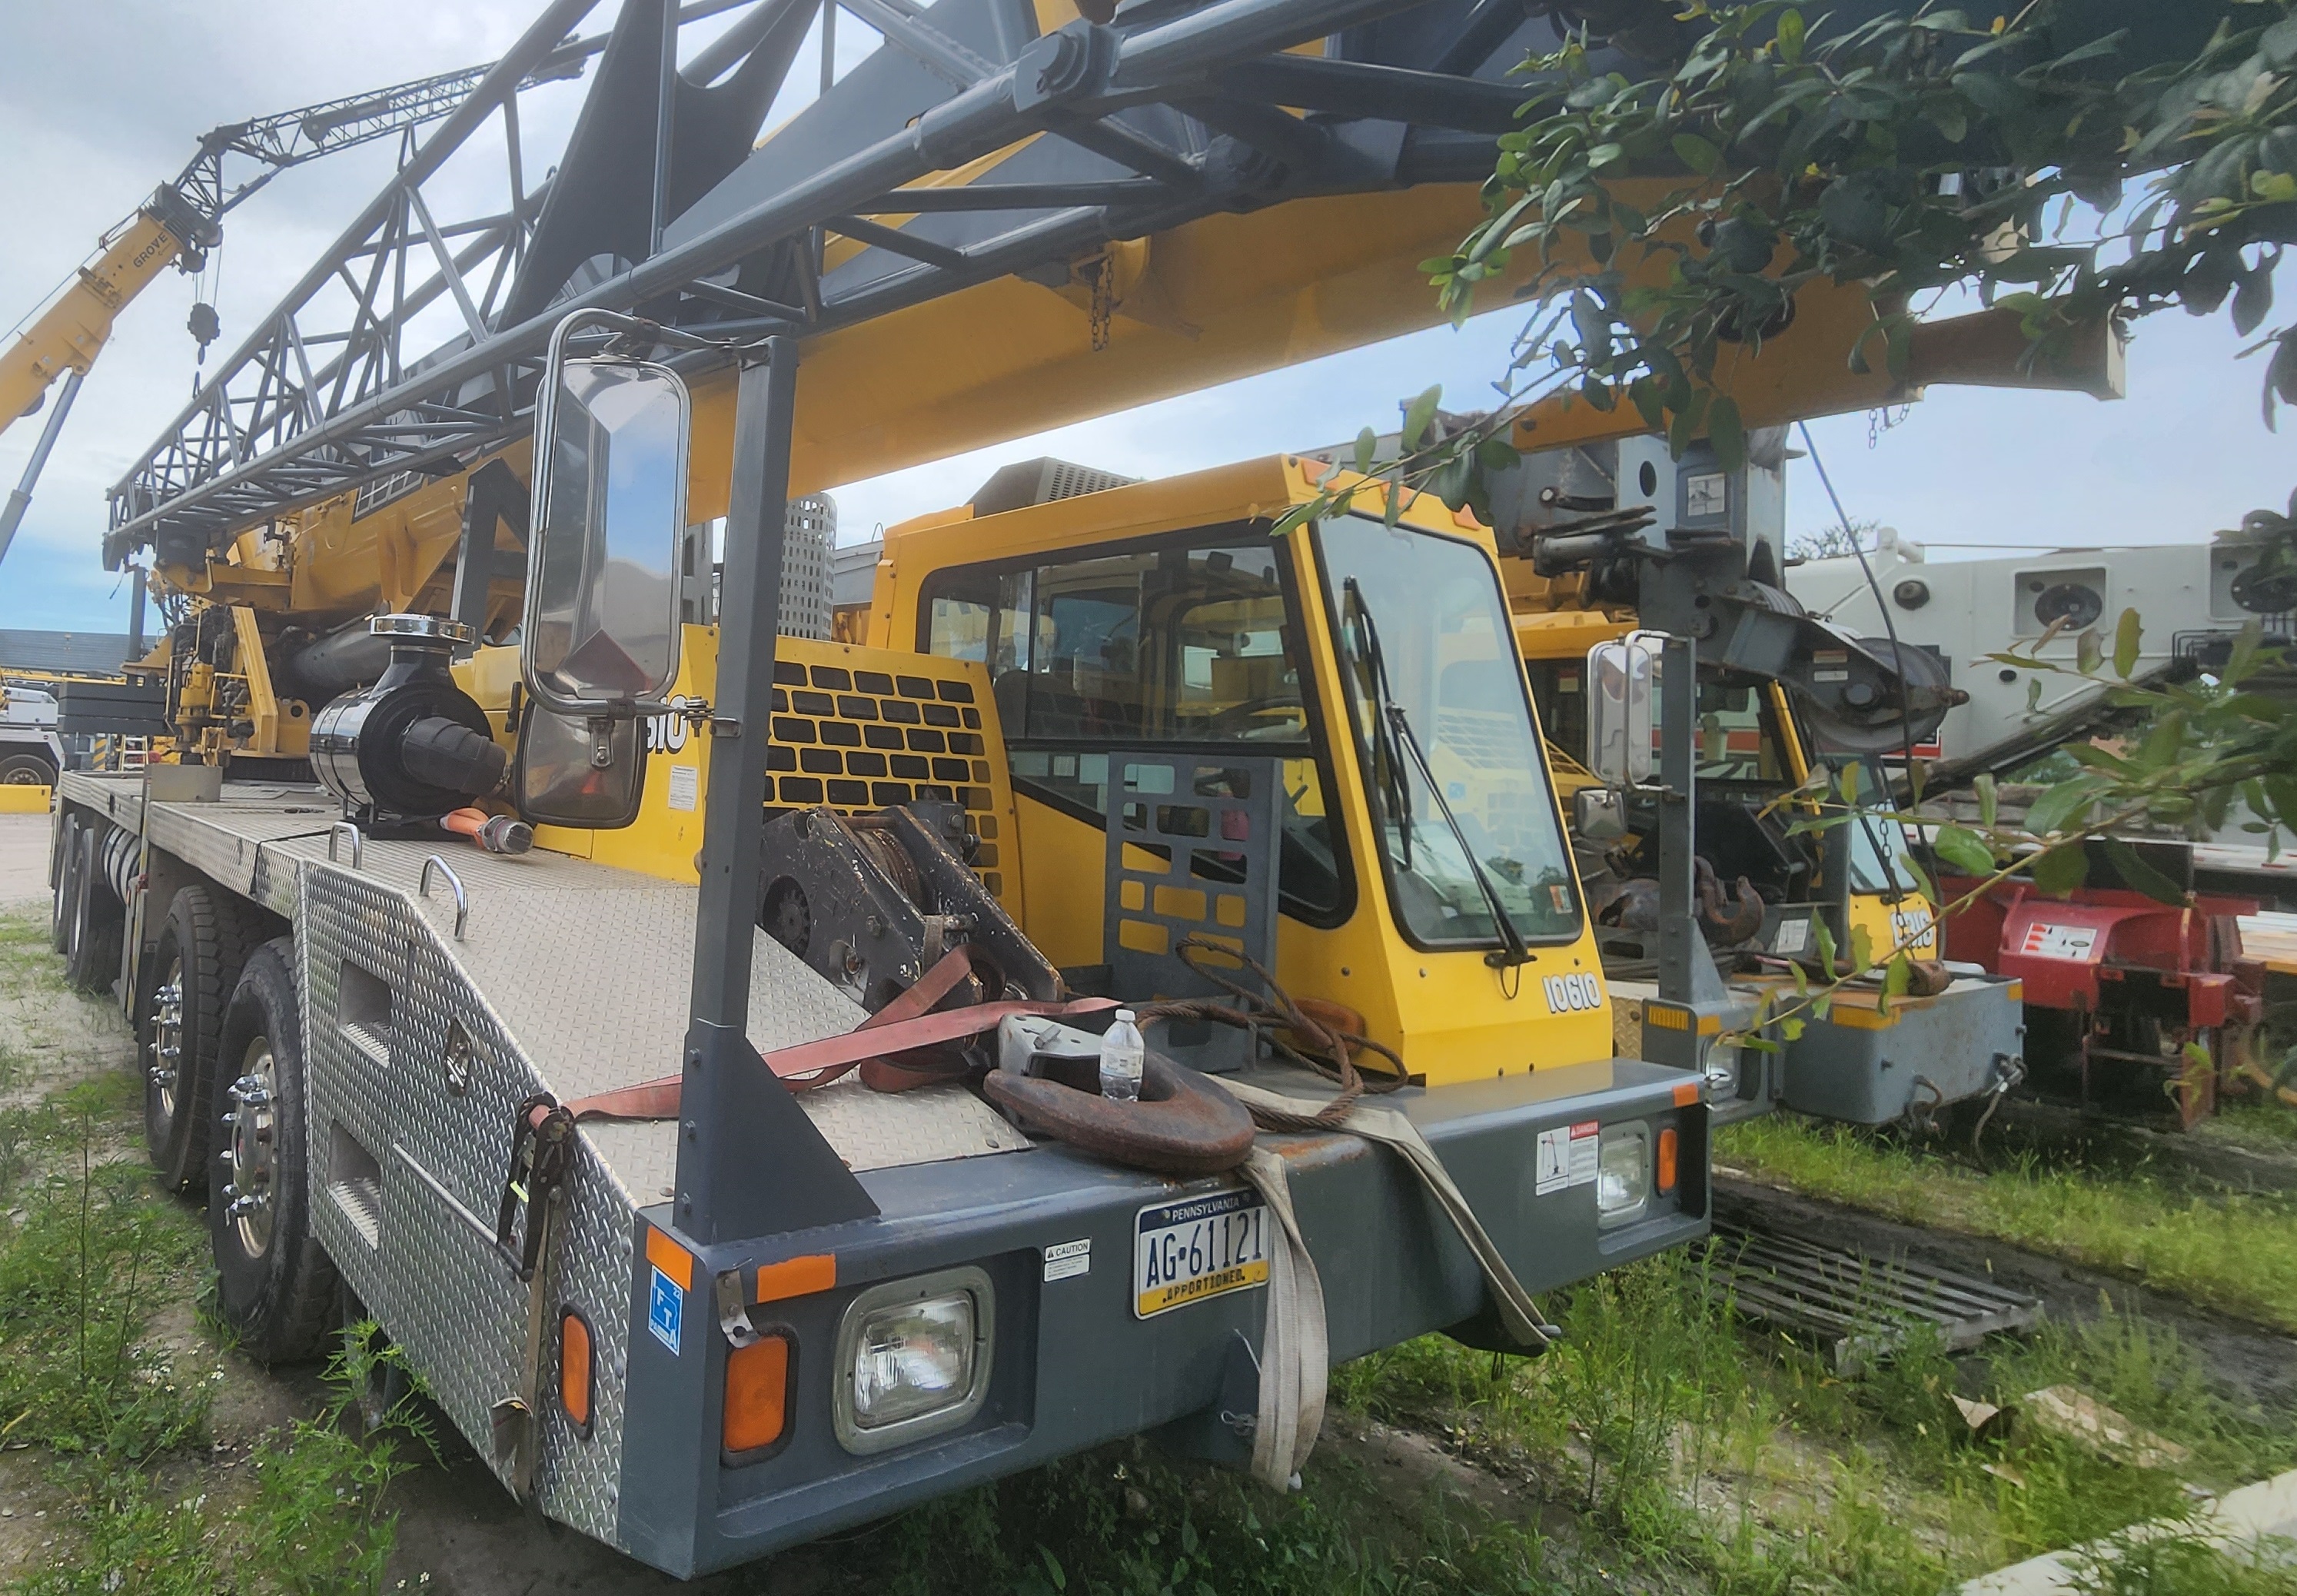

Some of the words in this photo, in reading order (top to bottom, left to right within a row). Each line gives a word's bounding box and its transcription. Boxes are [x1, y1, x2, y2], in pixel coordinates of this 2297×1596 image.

[133, 231, 168, 268] GROVE
[1542, 972, 1601, 1013] 10610
[1172, 1197, 1240, 1221] PENNSYLVANIA
[1056, 1242, 1089, 1256] CAUTION
[1167, 1268, 1242, 1300] APPORTIONED
